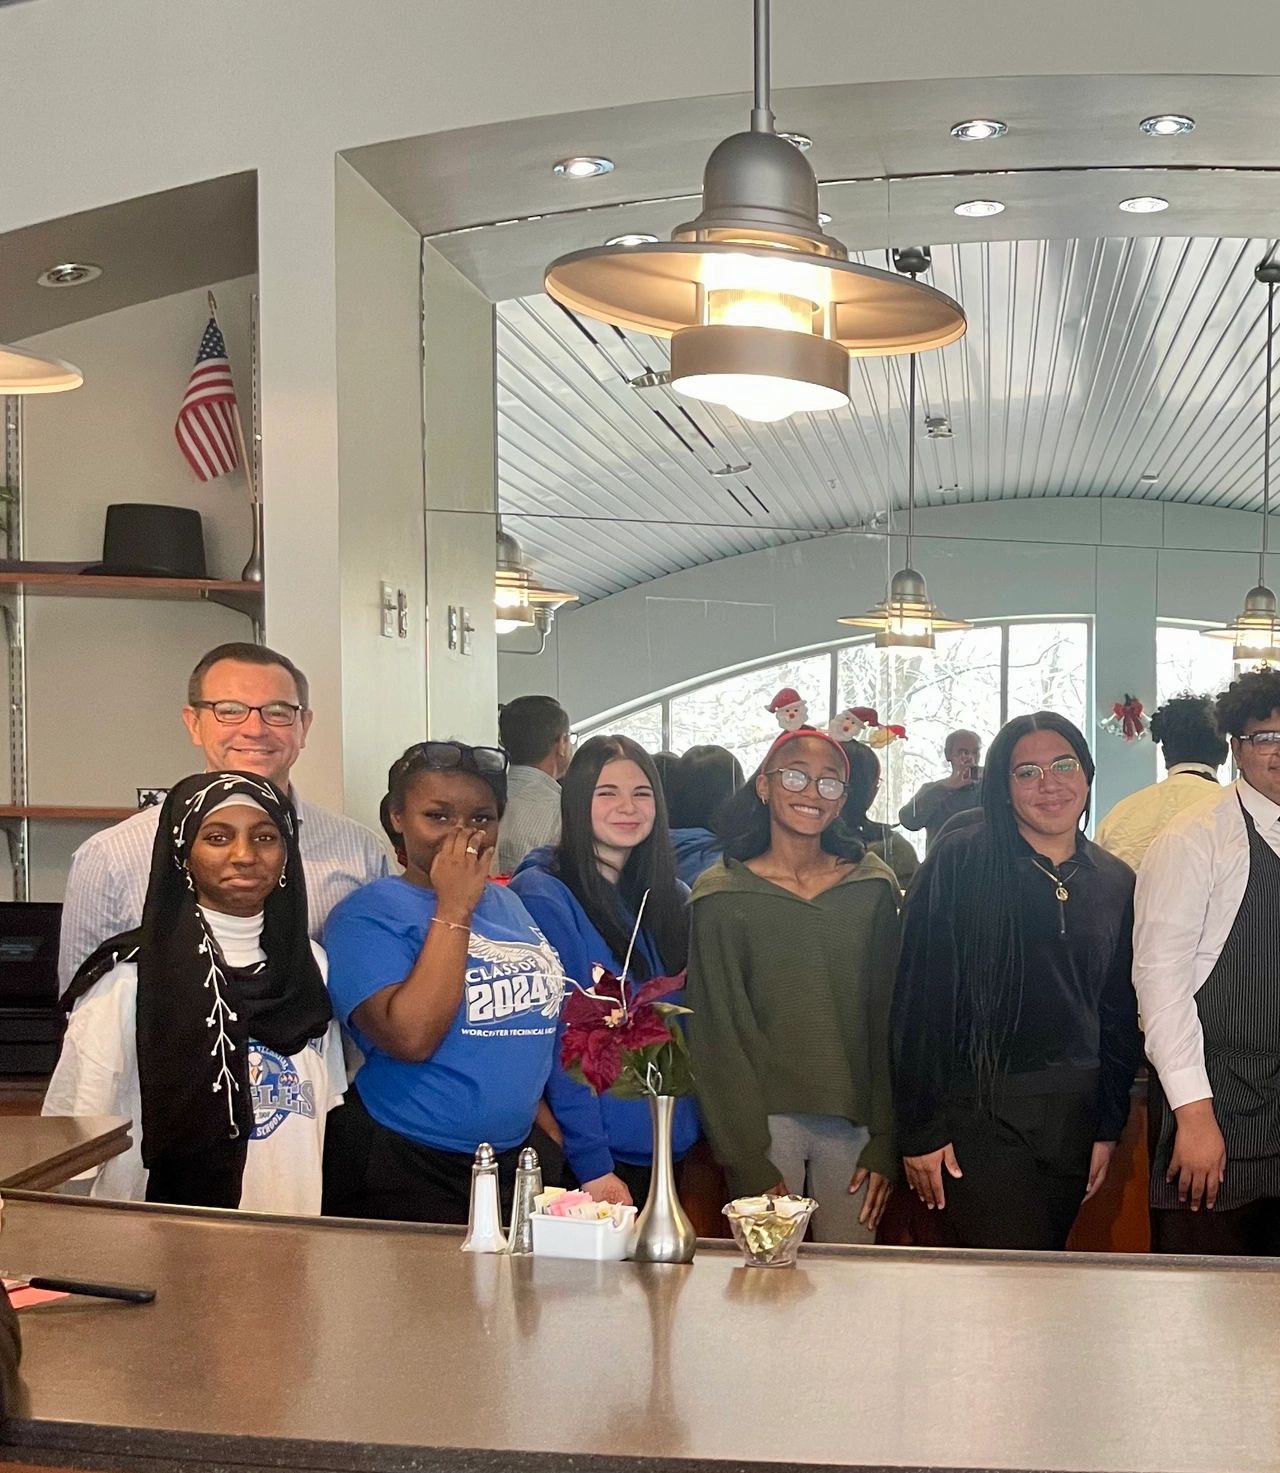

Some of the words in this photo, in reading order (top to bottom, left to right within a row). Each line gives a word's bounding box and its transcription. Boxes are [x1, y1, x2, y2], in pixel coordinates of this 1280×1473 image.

[465, 963, 519, 983] CLASS
[519, 957, 538, 972] OF
[467, 972, 549, 1022] 2024
[249, 1081, 316, 1119] LES
[256, 1113, 284, 1138] SCHOOL
